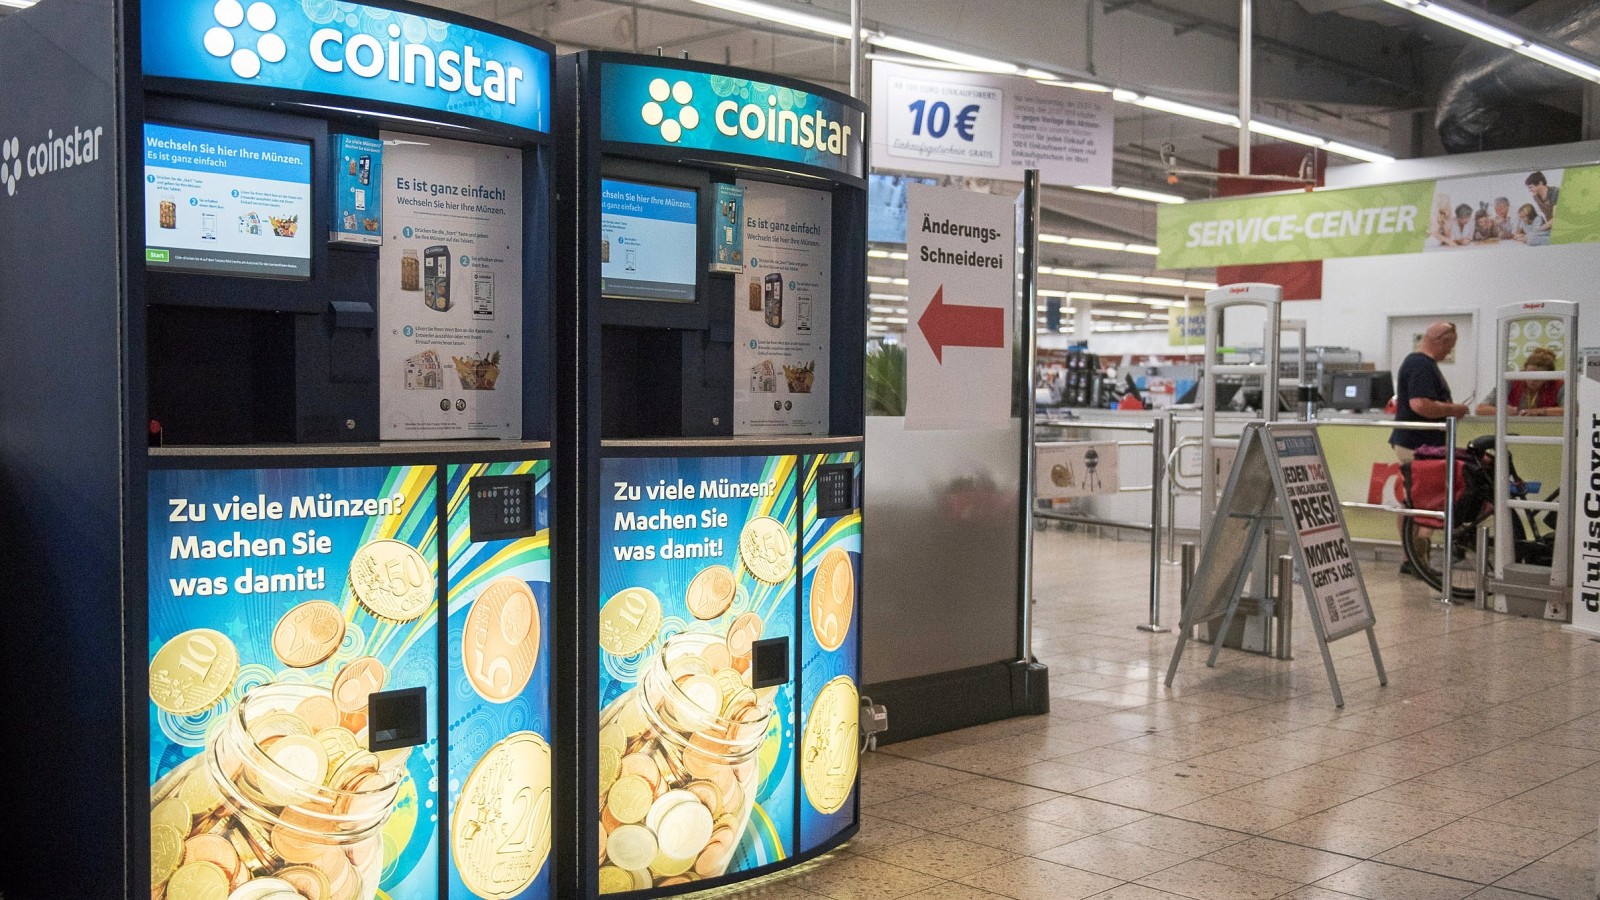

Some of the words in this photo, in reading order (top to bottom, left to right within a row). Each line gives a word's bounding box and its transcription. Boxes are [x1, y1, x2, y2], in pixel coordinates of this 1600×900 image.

[309, 24, 523, 105] coinstar
[715, 94, 851, 157] coinstar
[27, 125, 103, 177] coinstar
[147, 136, 197, 153] Wechseln
[200, 143, 215, 155] Sie
[218, 145, 237, 157] hier
[240, 149, 259, 160] Ihre
[262, 152, 303, 166] Münzen.
[147, 151, 157, 159] Es
[159, 152, 170, 161] ist
[172, 155, 192, 164] ganz
[194, 157, 227, 168] einfach!
[396, 177, 410, 190] Es
[413, 178, 427, 192] ist
[430, 184, 458, 196] ganz
[461, 184, 506, 201] einfach!
[625, 193, 635, 201] Sie
[637, 194, 649, 203] hier
[651, 196, 664, 206] Ihre
[665, 199, 692, 209] Münzen.
[397, 196, 432, 208] Wechseln
[434, 200, 444, 209] Sie
[446, 201, 459, 210] hier
[461, 203, 474, 212] Ihre
[476, 205, 506, 215] Münzen.
[607, 202, 621, 210] ganz
[621, 204, 643, 213] einfach!
[747, 217, 757, 228] Es
[758, 217, 768, 229] ist
[770, 222, 789, 233] ganz
[790, 222, 820, 235] einfach!
[747, 233, 771, 242] Wechseln
[780, 236, 789, 244] hier
[790, 237, 799, 245] Ihre
[921, 213, 1001, 243] Änderungs-
[1185, 205, 1418, 249] SERVICE-CENTER
[150, 251, 164, 259] Start
[920, 245, 1003, 269] Schneiderei
[1282, 464, 1308, 485] JEDEN
[1308, 463, 1325, 482] TAG
[614, 481, 641, 501] Zu
[646, 479, 695, 500] viele
[700, 478, 777, 499] Münzen?
[169, 498, 206, 522] Zu
[213, 494, 283, 521] viele
[289, 493, 405, 519] Münzen?
[614, 508, 697, 531] Machen
[700, 508, 728, 528] Sie
[1291, 496, 1337, 530] PREIS!
[169, 531, 286, 560] Machen
[292, 529, 332, 555] Sie
[613, 544, 656, 561] was
[660, 537, 724, 559] damit!
[1304, 538, 1349, 568] MONTAG
[169, 575, 228, 597] was
[234, 566, 325, 594] damit!
[1312, 567, 1338, 588] GEHT'S
[1338, 561, 1356, 582] LOS!
[618, 591, 649, 631] 10
[814, 606, 839, 646] 5
[177, 635, 218, 683] 10
[475, 648, 513, 695] 5
[496, 786, 551, 855] 20
